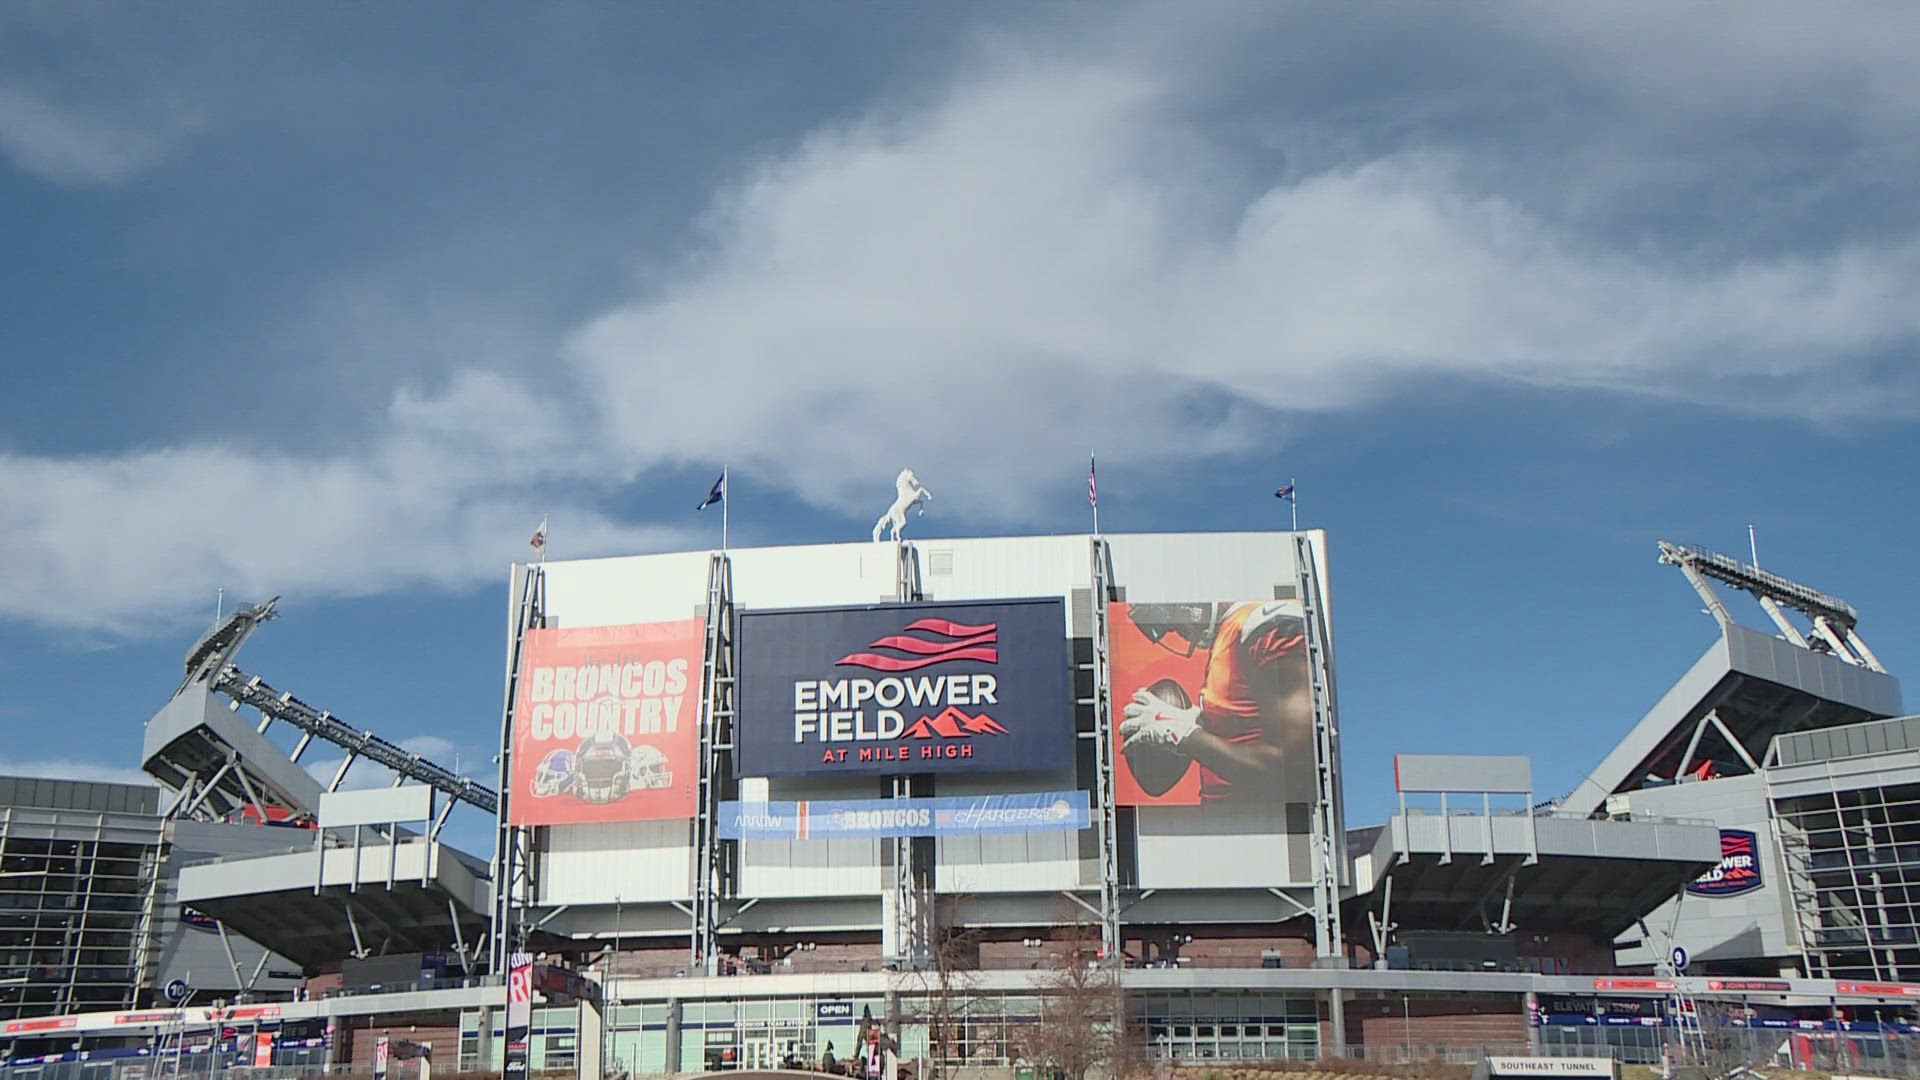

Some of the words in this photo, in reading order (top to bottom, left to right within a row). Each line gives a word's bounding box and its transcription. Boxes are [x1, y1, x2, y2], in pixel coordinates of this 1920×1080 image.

[531, 658, 688, 702] BRONCOS
[795, 674, 998, 711] EMPOWER
[531, 696, 683, 740] COUNTRY
[795, 709, 905, 742] FIELD
[823, 749, 848, 762] AT
[859, 746, 910, 760] MILE
[921, 744, 973, 759] HIGH
[843, 807, 930, 829] BRONCOS
[954, 795, 1051, 830] CHARGERS
[1674, 951, 1683, 965] 9
[170, 984, 185, 997] 10
[820, 1005, 849, 1015] OPEN
[1501, 1062, 1554, 1071] SOUTHEAST
[1561, 1062, 1597, 1071] TUNNEL
